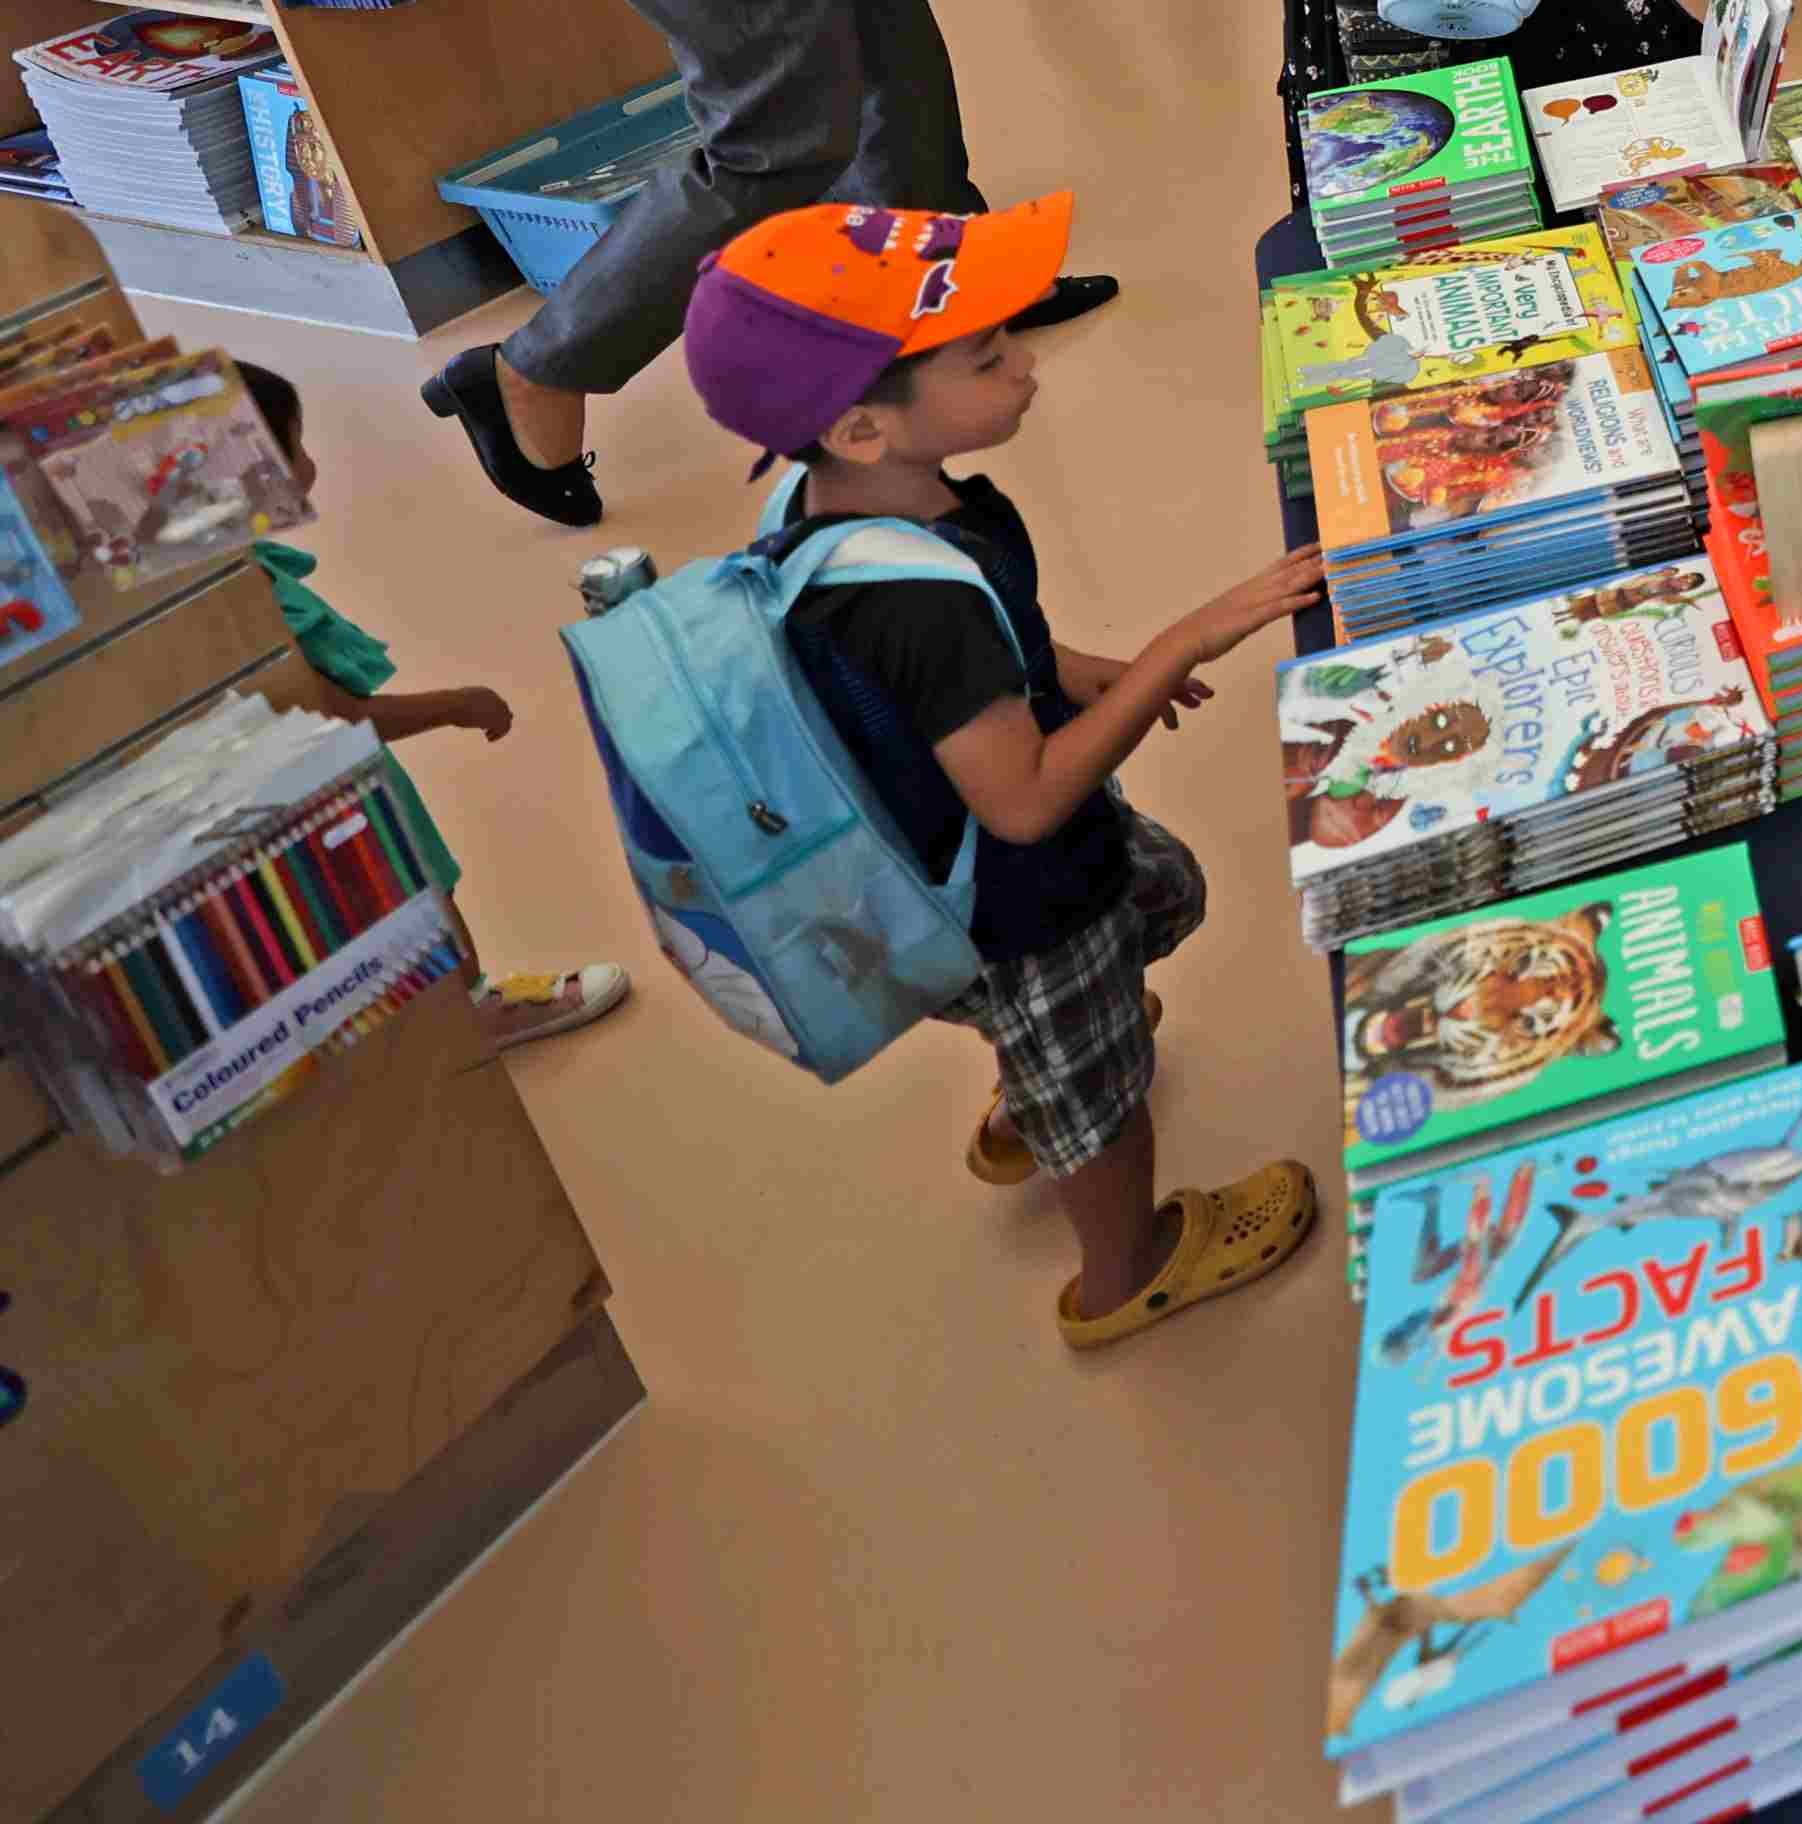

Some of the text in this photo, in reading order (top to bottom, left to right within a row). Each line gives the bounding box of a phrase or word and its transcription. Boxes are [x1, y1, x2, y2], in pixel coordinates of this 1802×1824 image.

[1452, 71, 1515, 160] EARTH
[1440, 274, 1486, 351] ANIMALS
[1474, 269, 1520, 340] IMPORTANT
[1514, 284, 1539, 321] Very
[1567, 398, 1603, 475] WORLDVIEWS?
[1588, 376, 1628, 467] RELIGIONS and
[1627, 406, 1653, 457] What are
[1459, 614, 1545, 787] Explorers
[1551, 650, 1598, 707] Epic
[1617, 883, 1702, 1062] ANIMALS
[170, 950, 385, 1114] Coloured Pencils
[1446, 1225, 1765, 1389] FACTS
[1404, 1282, 1802, 1468] AWESOME
[174, 1705, 239, 1775] 14
